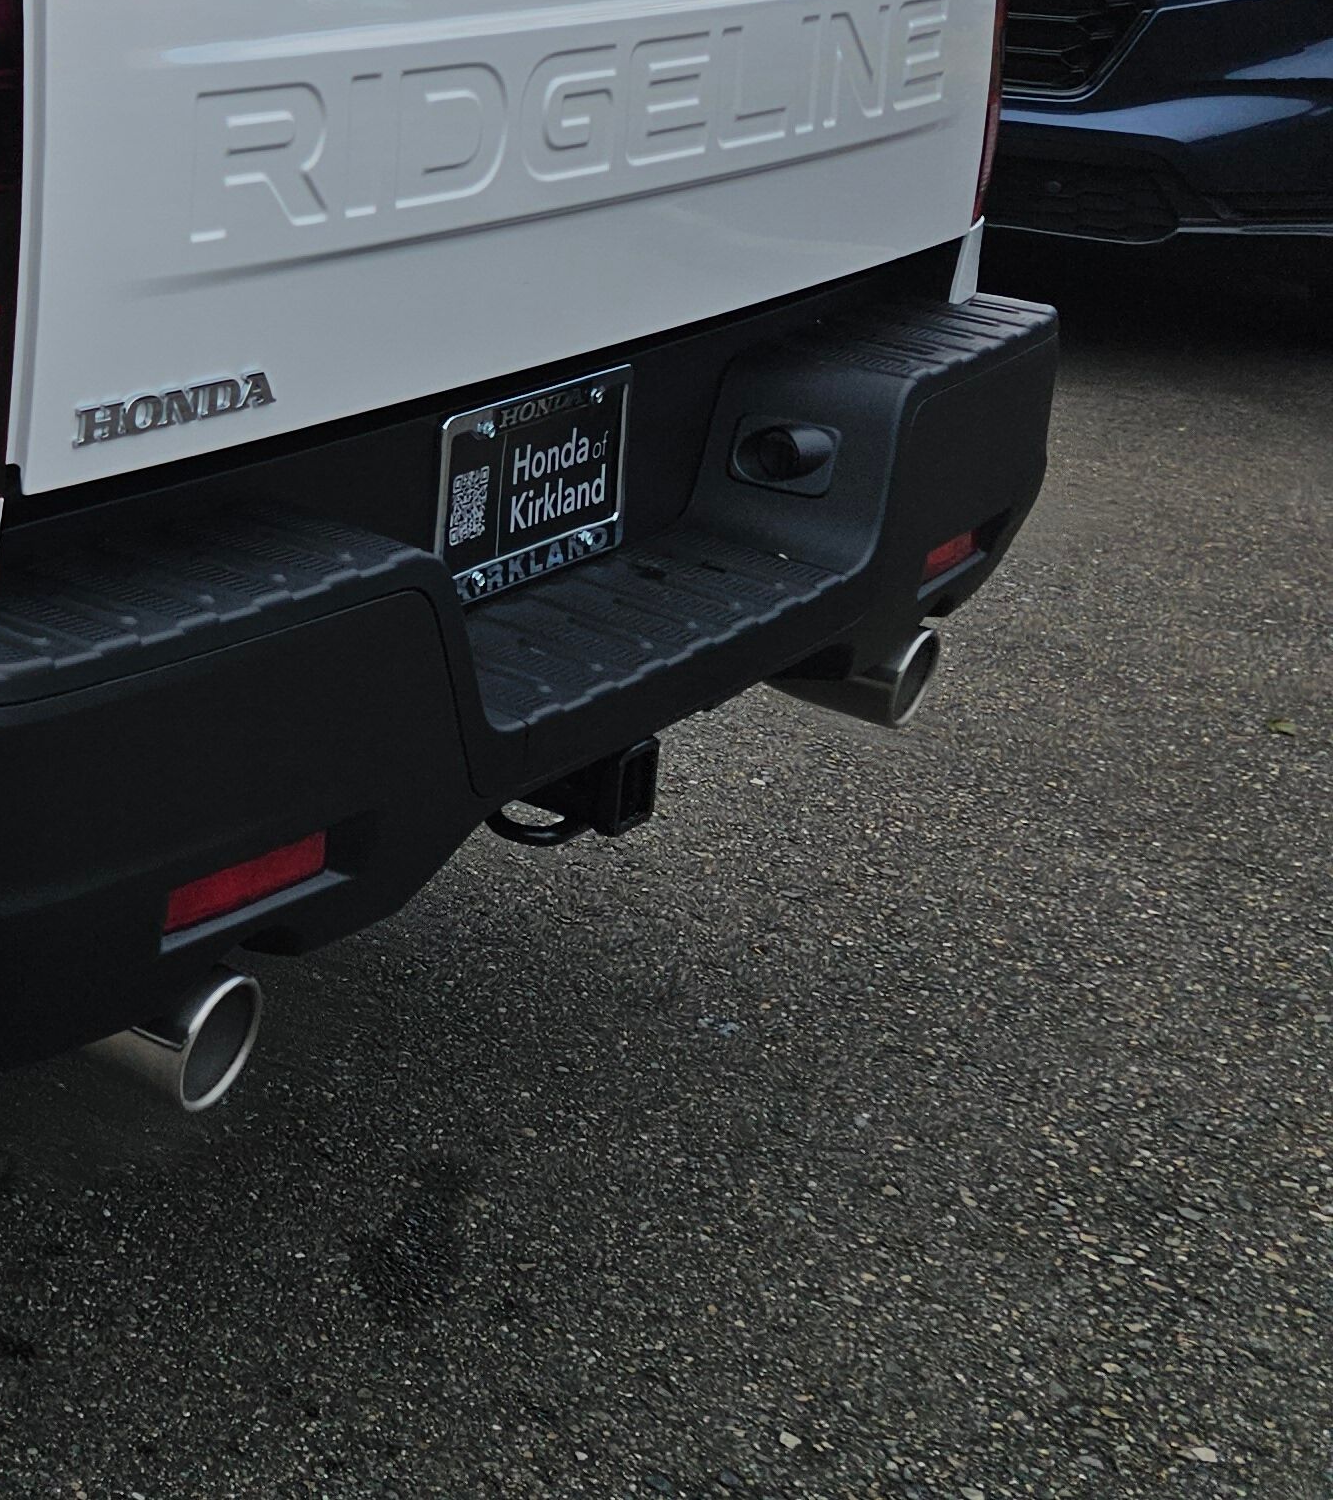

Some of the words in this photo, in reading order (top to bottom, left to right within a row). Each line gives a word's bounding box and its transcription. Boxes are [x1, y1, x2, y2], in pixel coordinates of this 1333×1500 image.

[72, 372, 276, 449] HONDA
[512, 427, 590, 485] Honda
[592, 430, 609, 460] of
[509, 463, 607, 534] Kirkland
